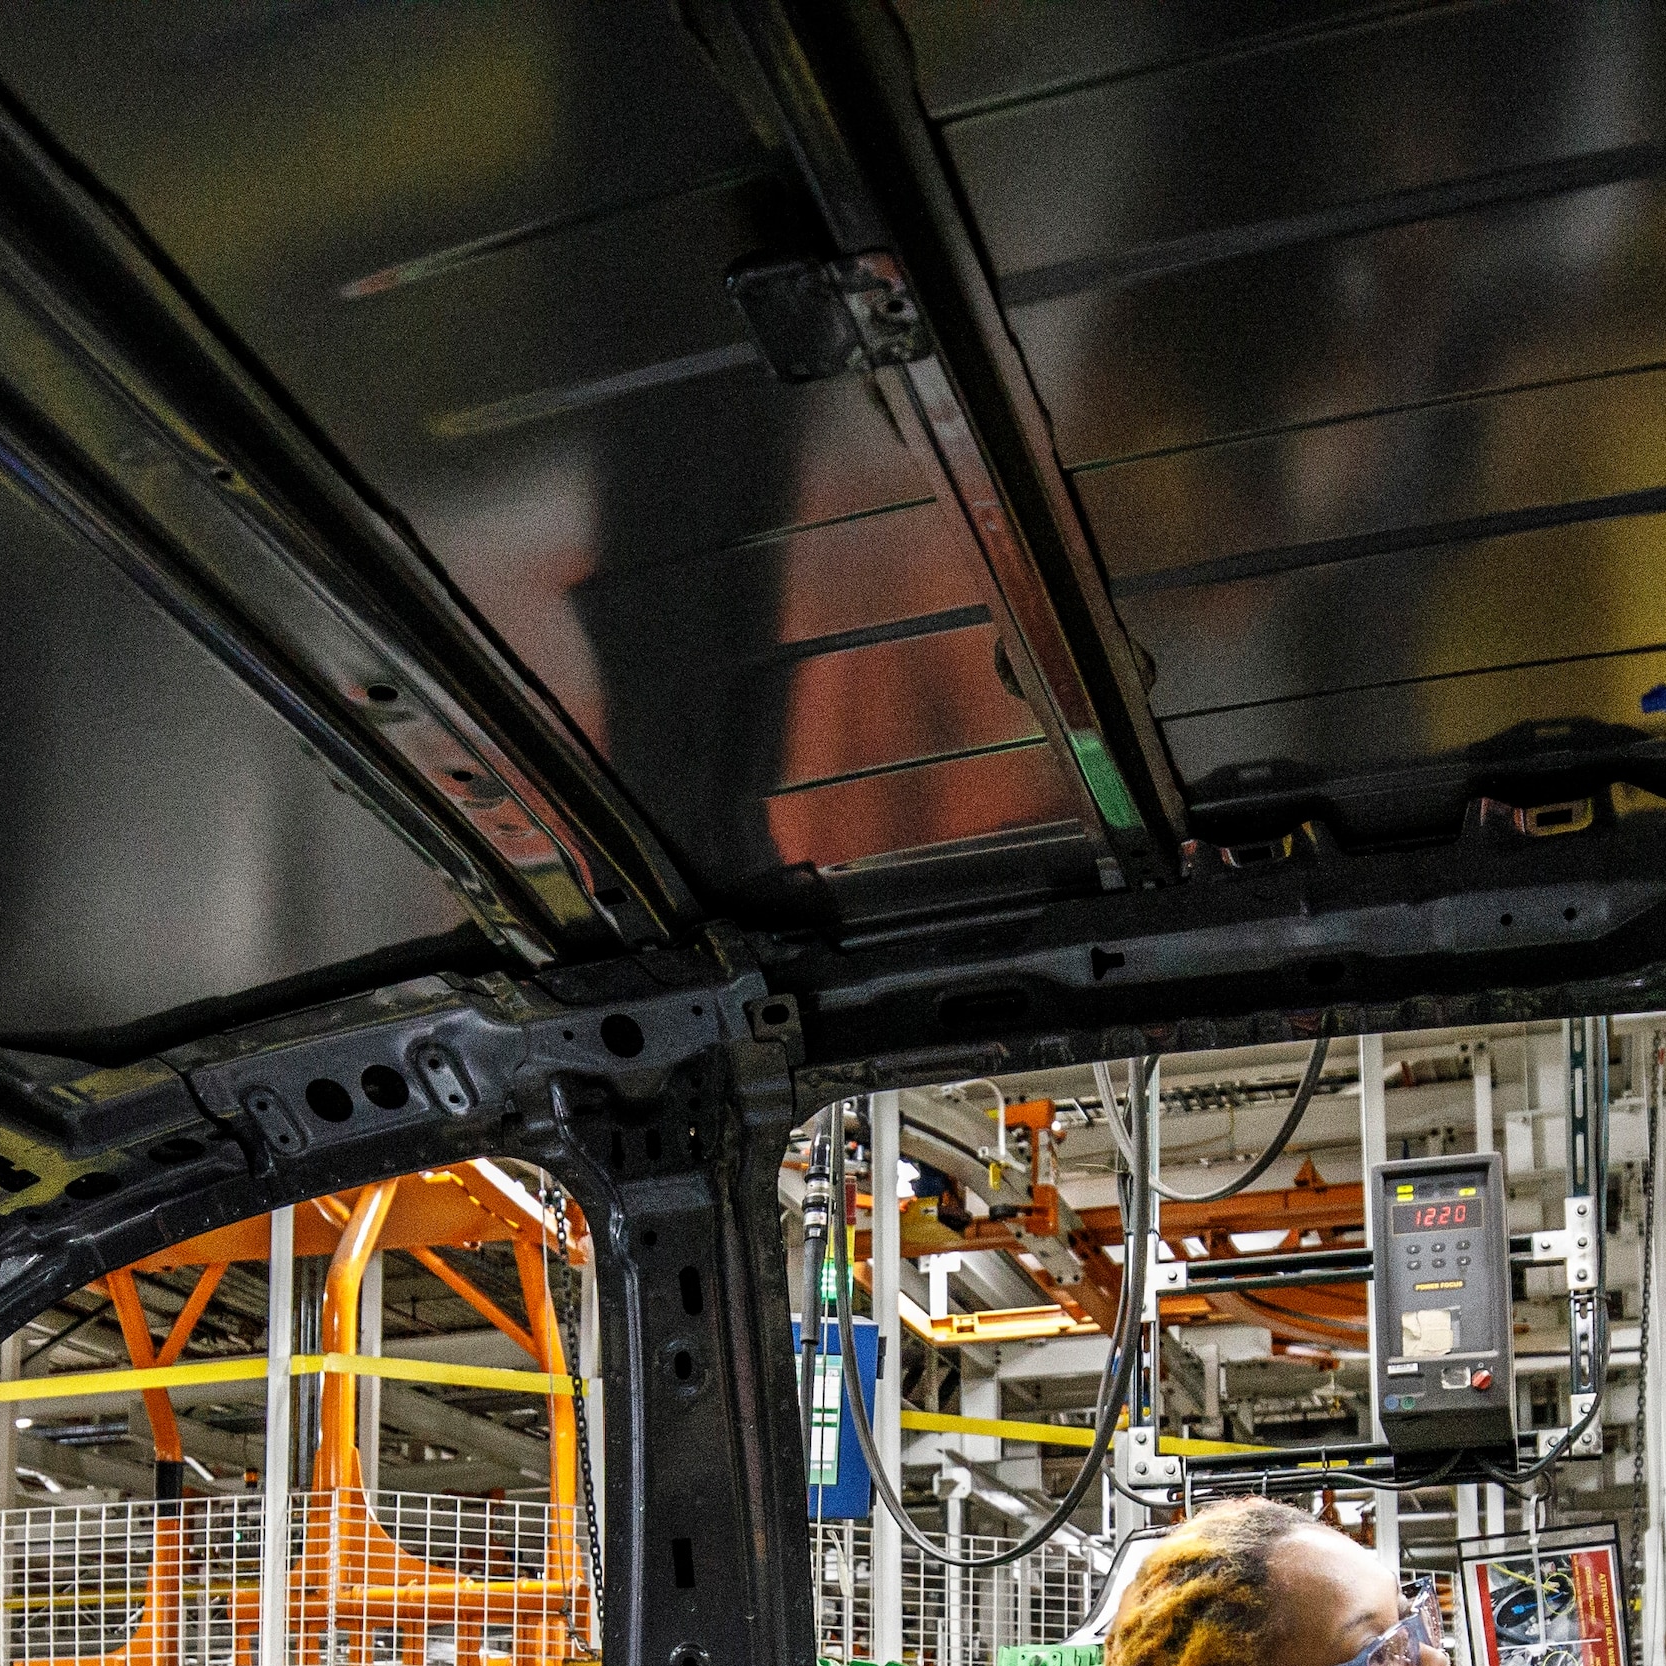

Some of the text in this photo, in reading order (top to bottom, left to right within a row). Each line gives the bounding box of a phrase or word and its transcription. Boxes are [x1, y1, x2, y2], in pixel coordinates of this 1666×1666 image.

[1414, 1204, 1467, 1228] 1220
[1415, 1280, 1464, 1291] POWER FOCUS
[1598, 1572, 1611, 1627] ATTENTION!!!
[1605, 1626, 1614, 1646] BLUE
